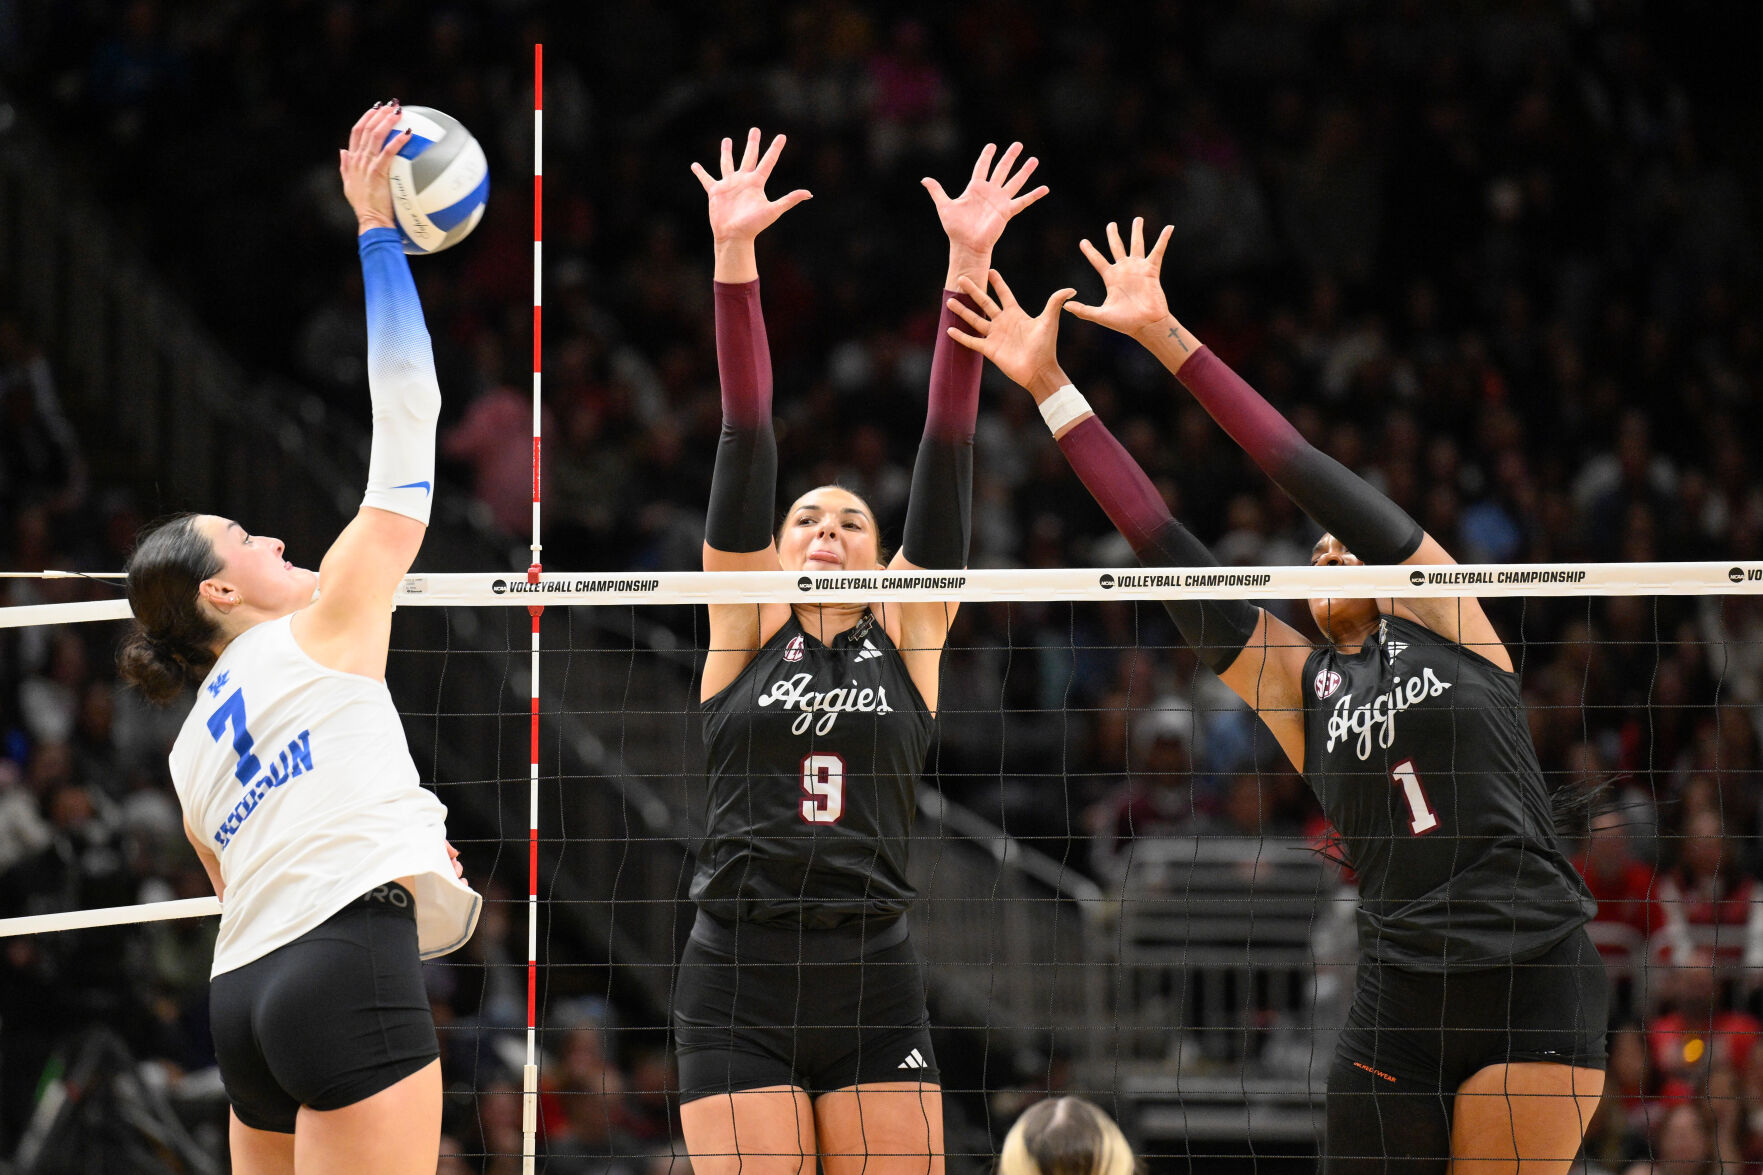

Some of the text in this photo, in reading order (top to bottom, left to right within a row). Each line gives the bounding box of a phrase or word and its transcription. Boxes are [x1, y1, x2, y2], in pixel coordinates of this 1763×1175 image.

[509, 581, 572, 593] VOLLEYBALL
[575, 580, 659, 592] CHAMPIONSHIP
[815, 578, 879, 590] VOLLEYBALL
[881, 577, 966, 589] CHAMPIONSHIP
[1117, 575, 1181, 588] VOLLEYBALL
[1184, 574, 1271, 587] CHAMPIONSHIP
[1428, 572, 1494, 585] VOLLEYBALL
[1497, 571, 1586, 584] CHAMPIONSHIP
[758, 673, 894, 736] Aggies
[1326, 667, 1452, 760] Aggies
[206, 687, 262, 787] 7
[800, 753, 845, 824] 9
[1391, 758, 1439, 835] 1
